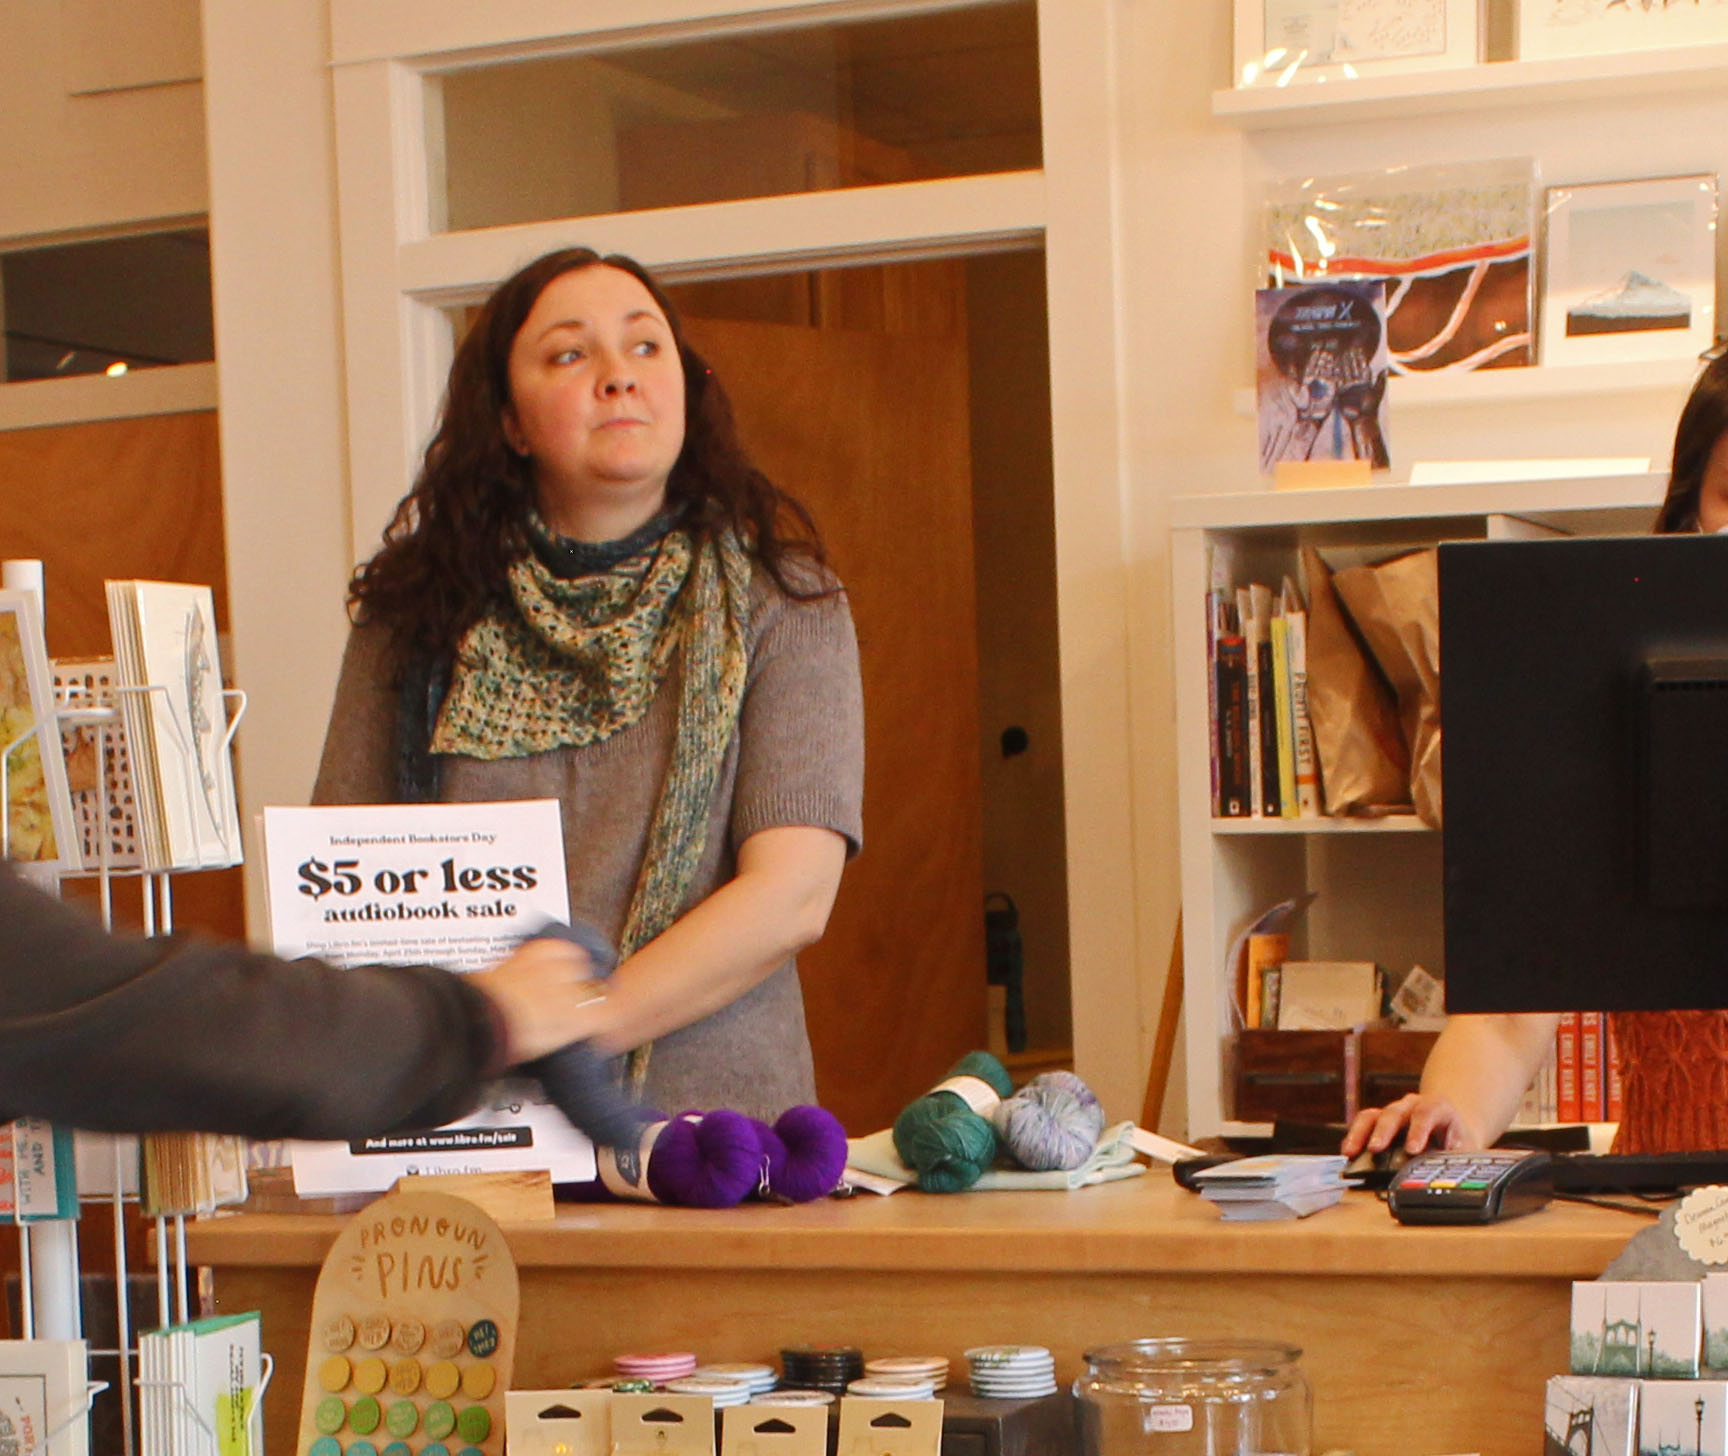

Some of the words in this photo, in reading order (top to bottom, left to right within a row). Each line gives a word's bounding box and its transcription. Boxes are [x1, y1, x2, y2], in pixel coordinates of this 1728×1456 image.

[329, 834, 406, 847] Independent
[471, 832, 497, 845] Day
[297, 856, 363, 902] $5
[374, 867, 429, 895] or
[440, 857, 539, 893] less
[323, 901, 460, 923] audiobook
[465, 899, 518, 919] sale
[365, 1137, 388, 1150] And
[359, 1215, 489, 1250] PRONOUN
[375, 1250, 463, 1299] PINS
